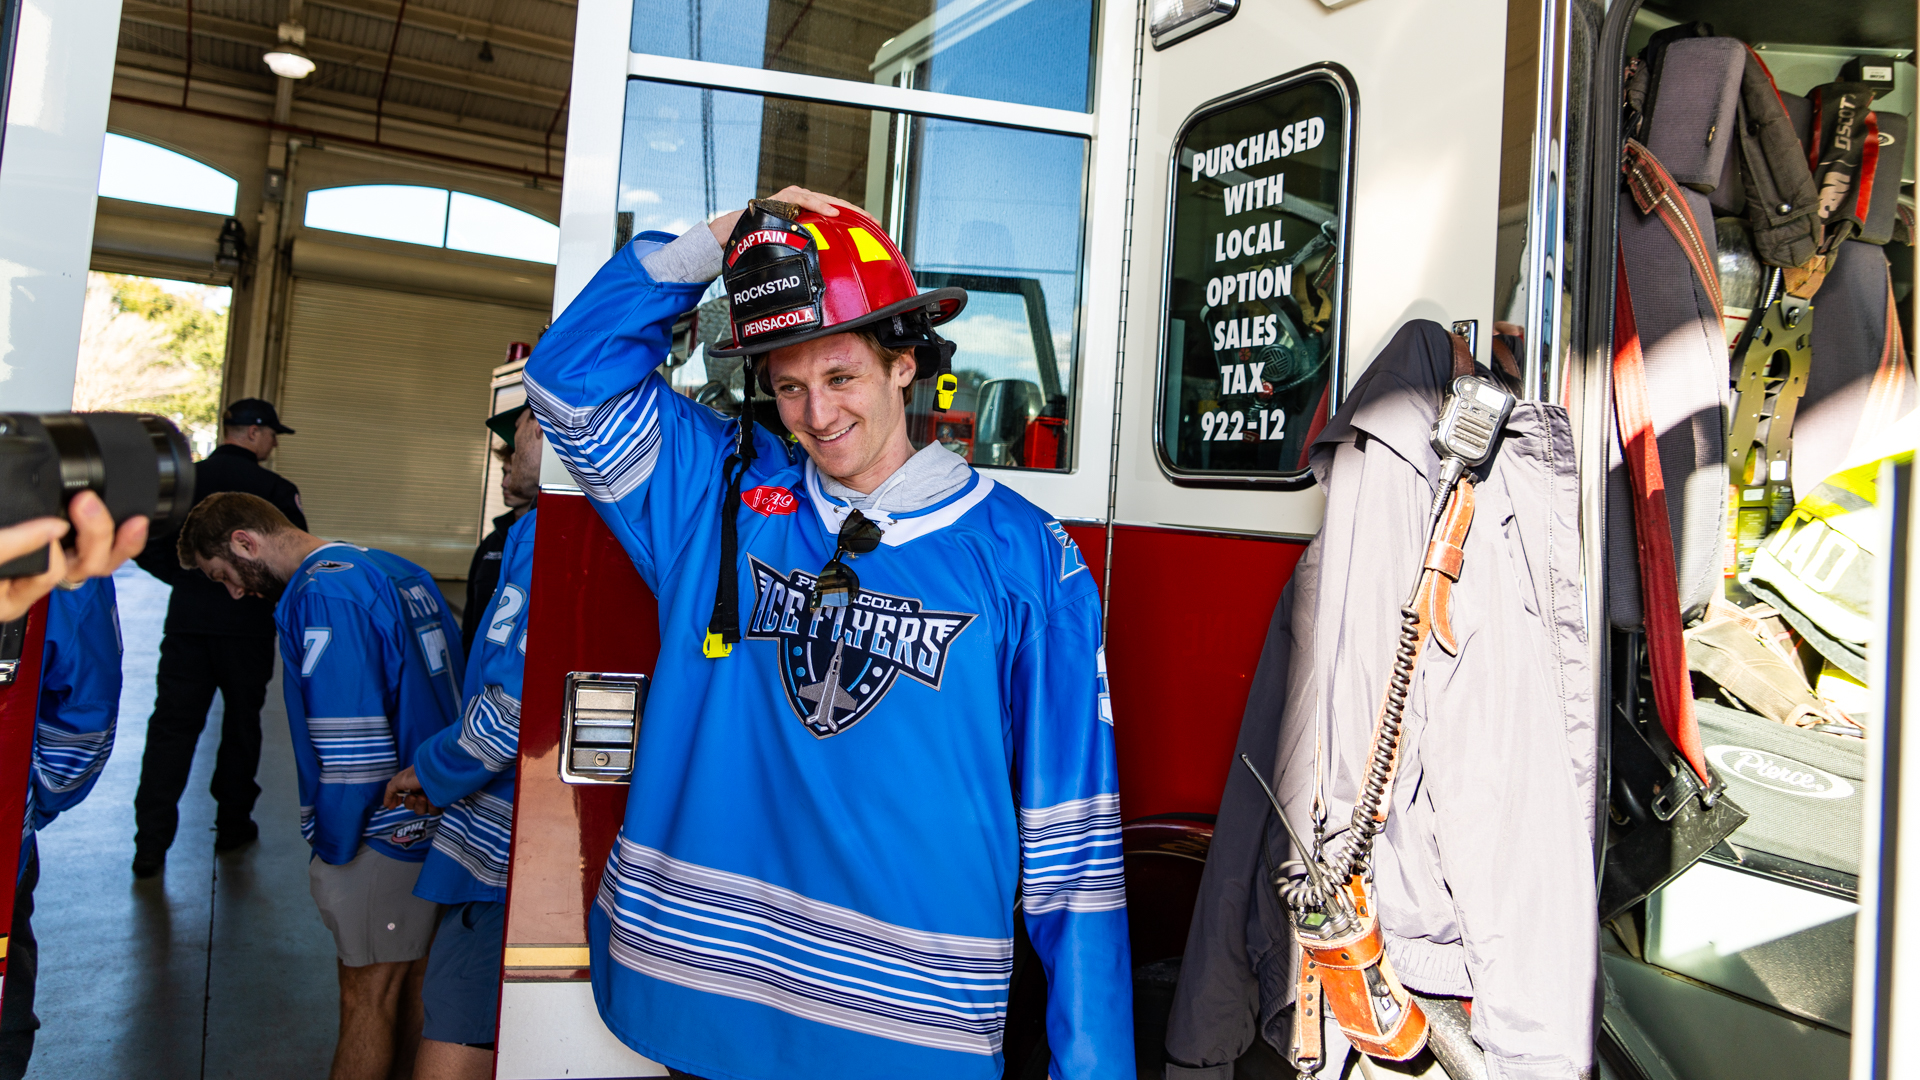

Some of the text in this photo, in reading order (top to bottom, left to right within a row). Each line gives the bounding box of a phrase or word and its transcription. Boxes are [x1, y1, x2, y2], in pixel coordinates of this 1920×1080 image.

[1191, 116, 1325, 182] PURCHASED
[1223, 173, 1284, 216] WITH
[737, 230, 787, 255] CAPTAIN
[1215, 220, 1285, 262] LOCAL
[734, 275, 800, 306] ROCKSTAD
[1206, 265, 1292, 307] OPTION
[744, 307, 815, 337] PENSACOLA
[1213, 314, 1278, 351] SALES
[1221, 362, 1265, 395] TAX
[1201, 409, 1285, 441] 922-12
[752, 570, 962, 679] ICE FLYERS
[301, 627, 332, 677] 7
[1734, 751, 1816, 788] Pierce
